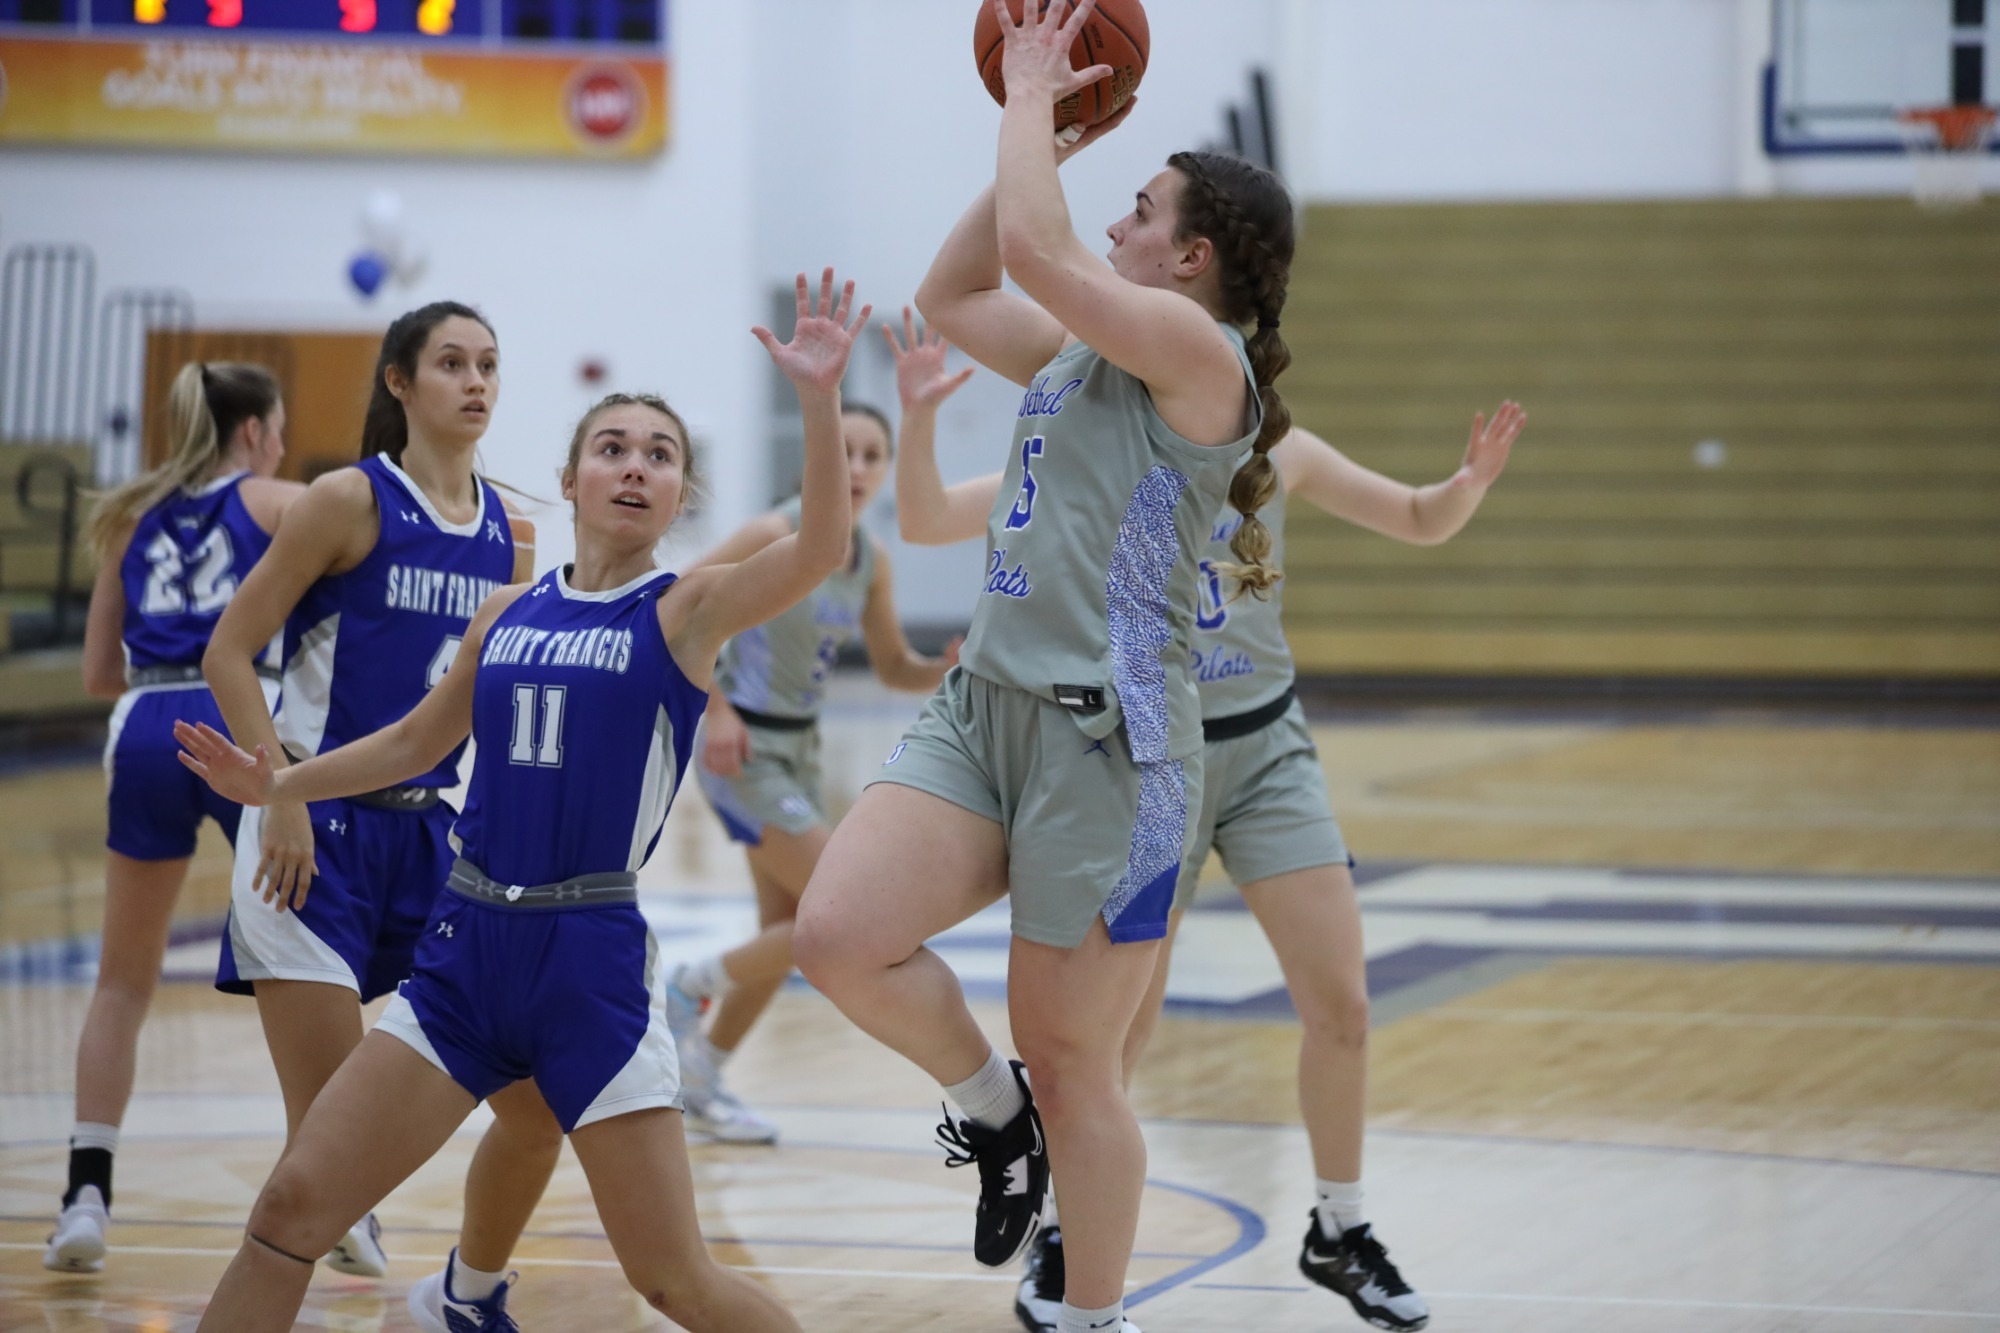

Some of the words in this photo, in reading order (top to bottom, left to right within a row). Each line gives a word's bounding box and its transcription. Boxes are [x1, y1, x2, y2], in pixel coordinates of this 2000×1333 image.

[139, 524, 238, 616] 22
[385, 563, 446, 615] SAINT
[445, 572, 504, 621] FRAN
[481, 625, 551, 667] SAINT
[538, 626, 634, 675] FRANCIS
[508, 683, 568, 769] 11
